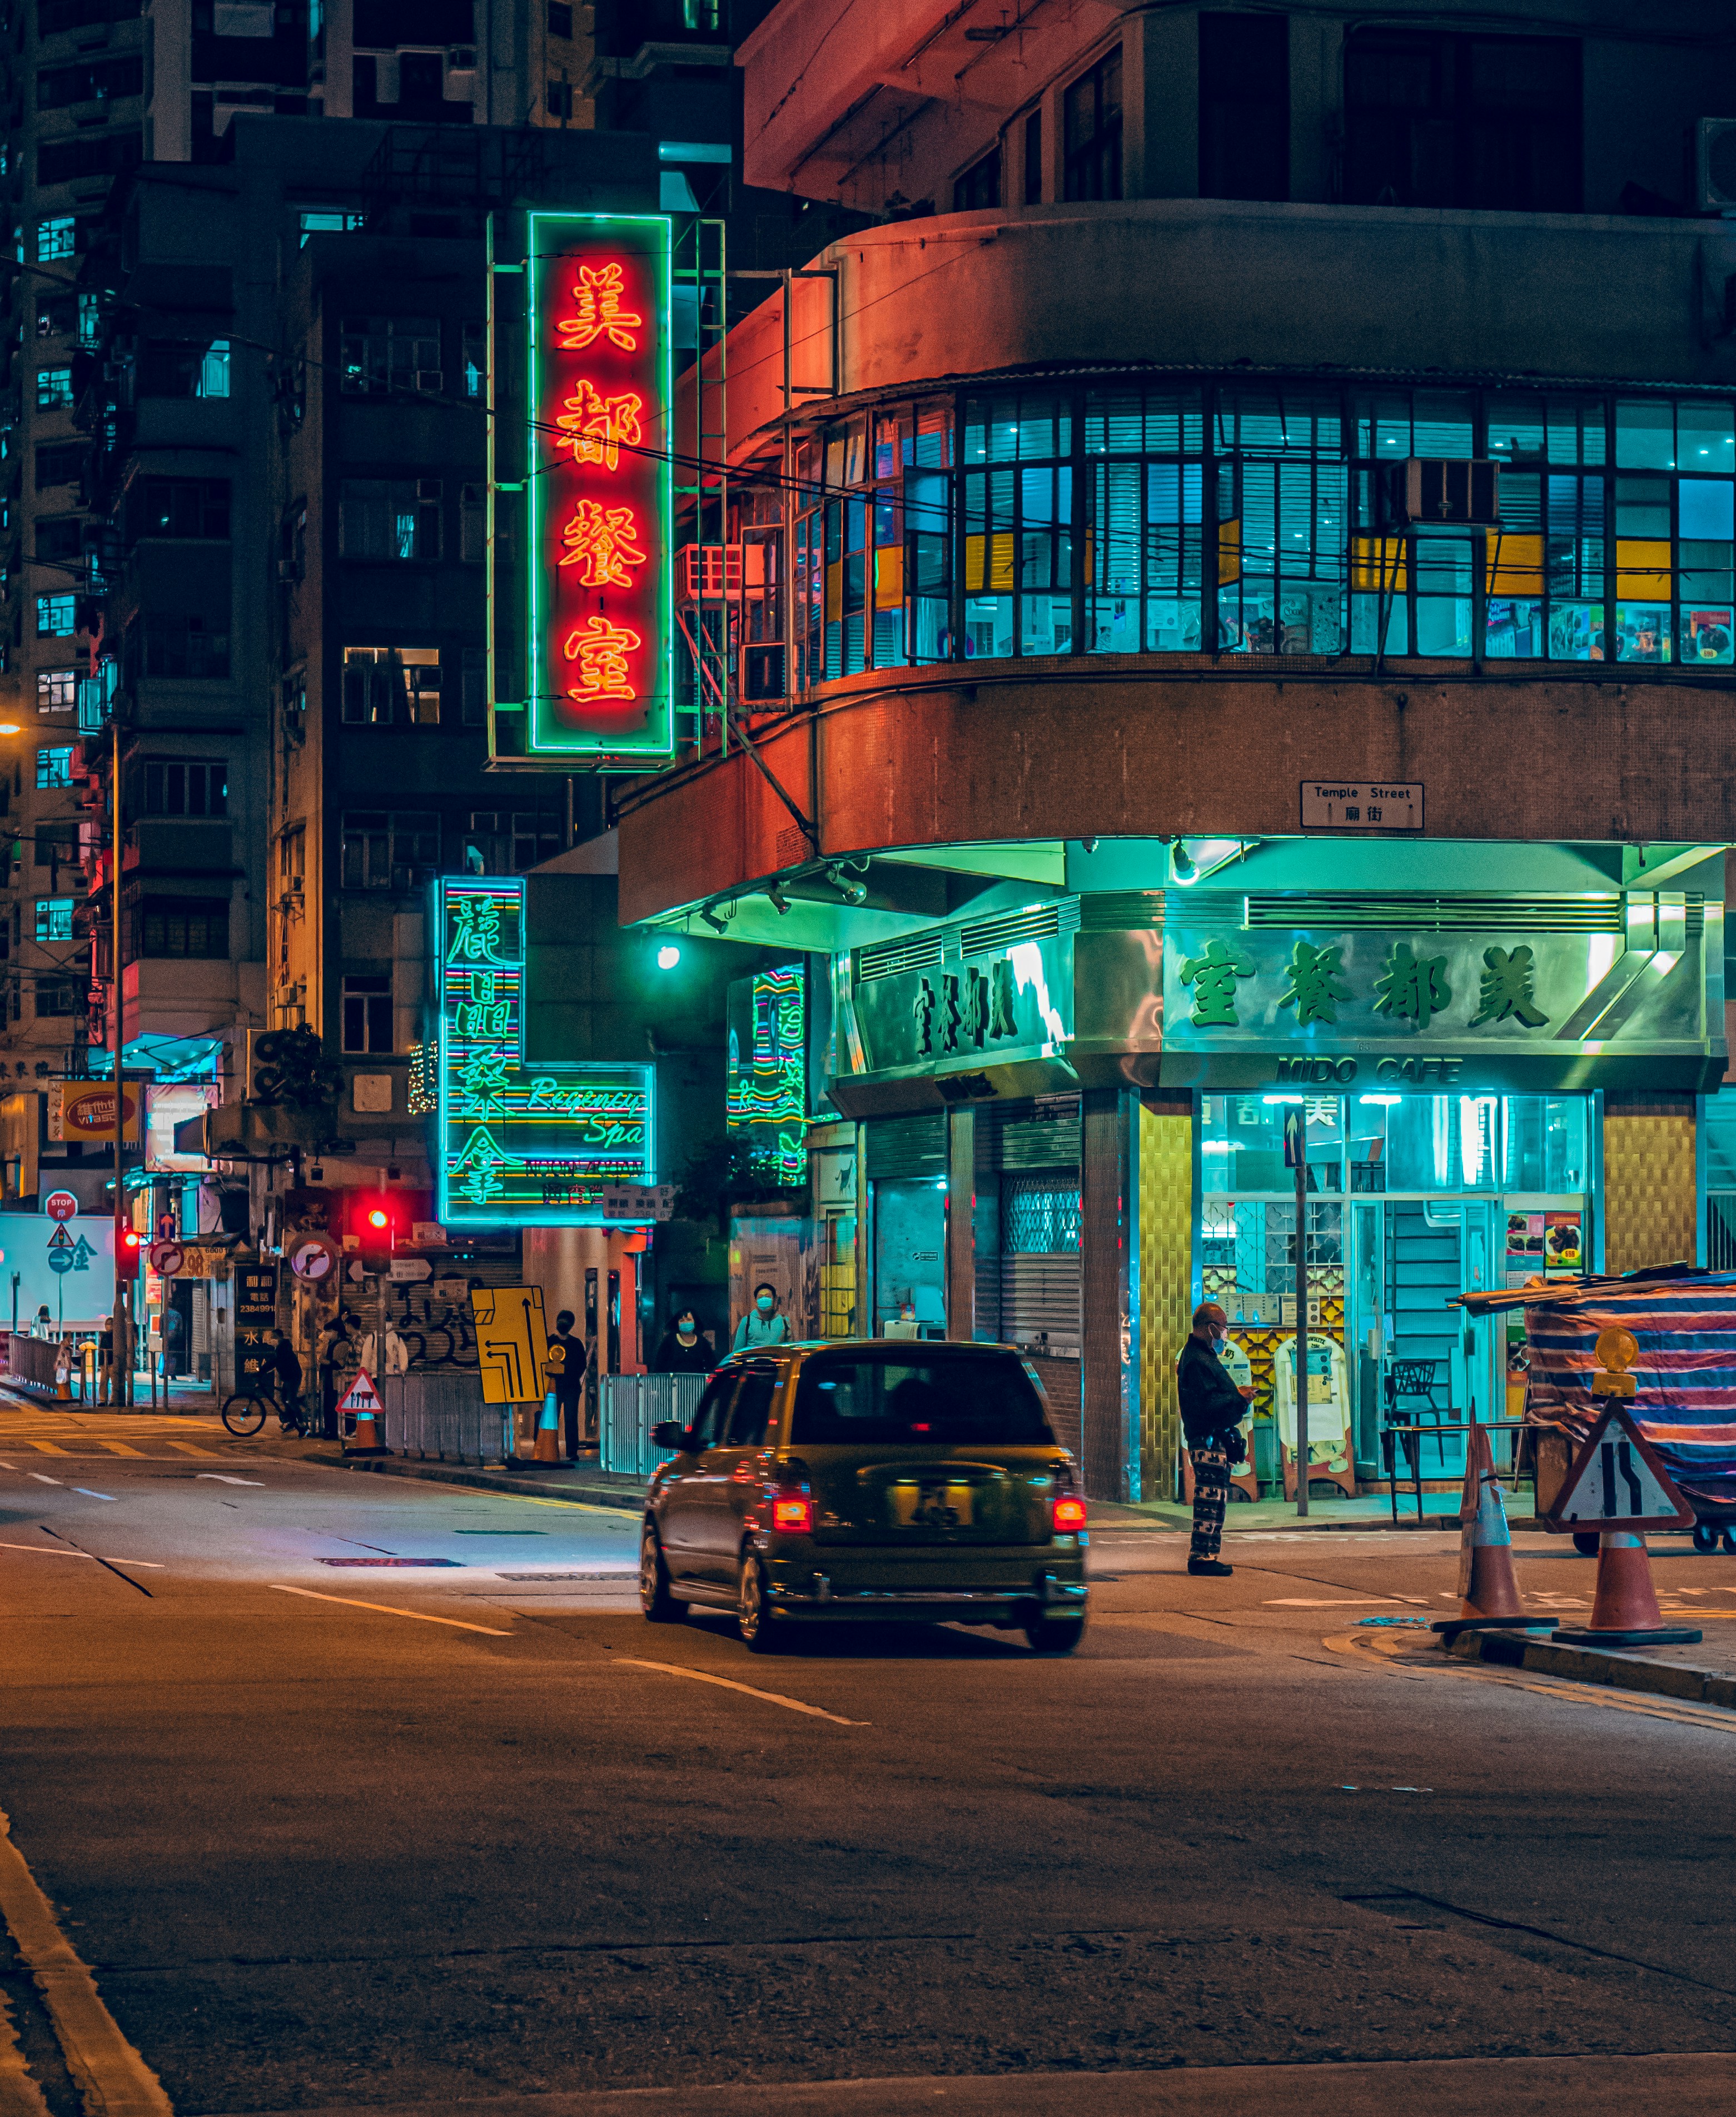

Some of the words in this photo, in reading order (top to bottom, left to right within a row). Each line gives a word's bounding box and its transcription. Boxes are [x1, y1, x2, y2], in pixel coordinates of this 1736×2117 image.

[558, 262, 646, 703] 美都餐室
[1315, 787, 1358, 799] Temple
[1371, 787, 1410, 799] Street
[1346, 806, 1382, 822] 廟街
[447, 894, 525, 1205] 麗晶桑拿
[1276, 1056, 1358, 1084] MIDO
[1376, 1056, 1463, 1085] CAFE
[527, 1077, 640, 1119] Regency
[584, 1112, 645, 1149] Spa
[187, 1254, 204, 1277] 98
